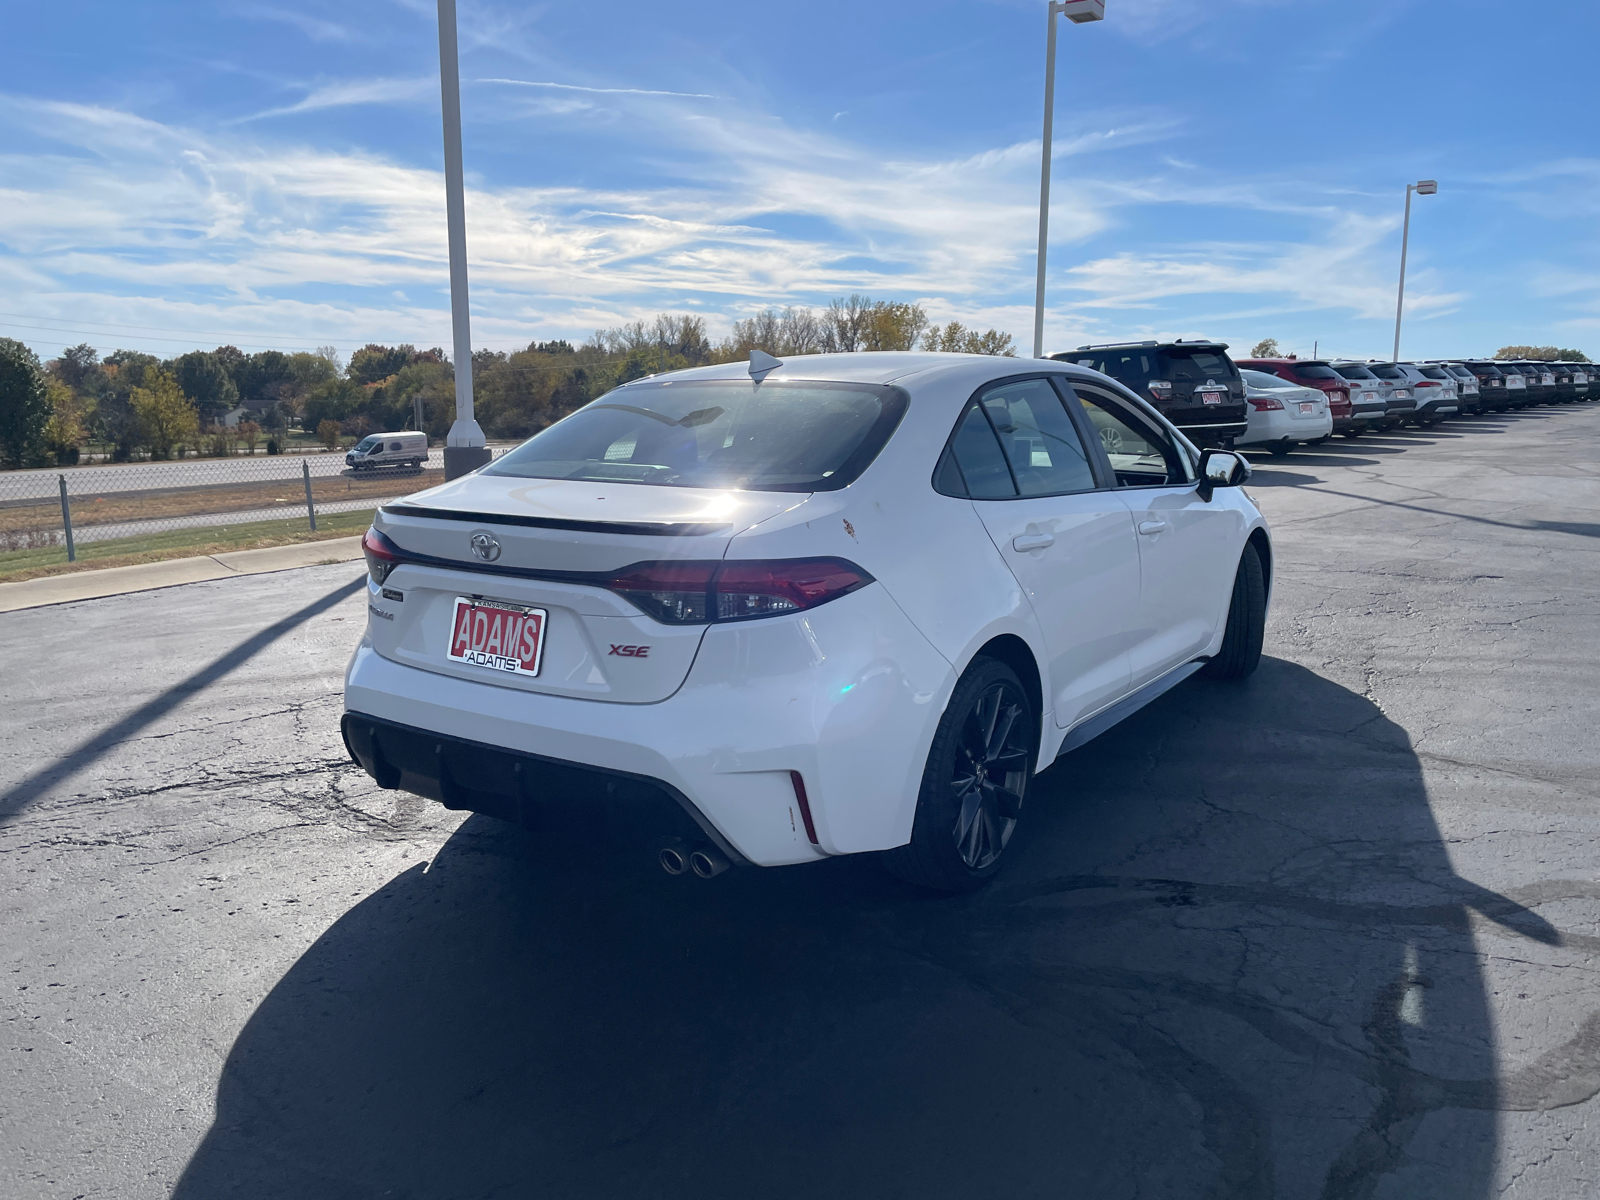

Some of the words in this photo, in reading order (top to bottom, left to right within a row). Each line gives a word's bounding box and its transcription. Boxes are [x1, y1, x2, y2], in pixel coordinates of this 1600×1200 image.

[455, 609, 537, 662] ADAMS
[608, 644, 651, 657] XSE
[467, 652, 517, 671] ADAMS
